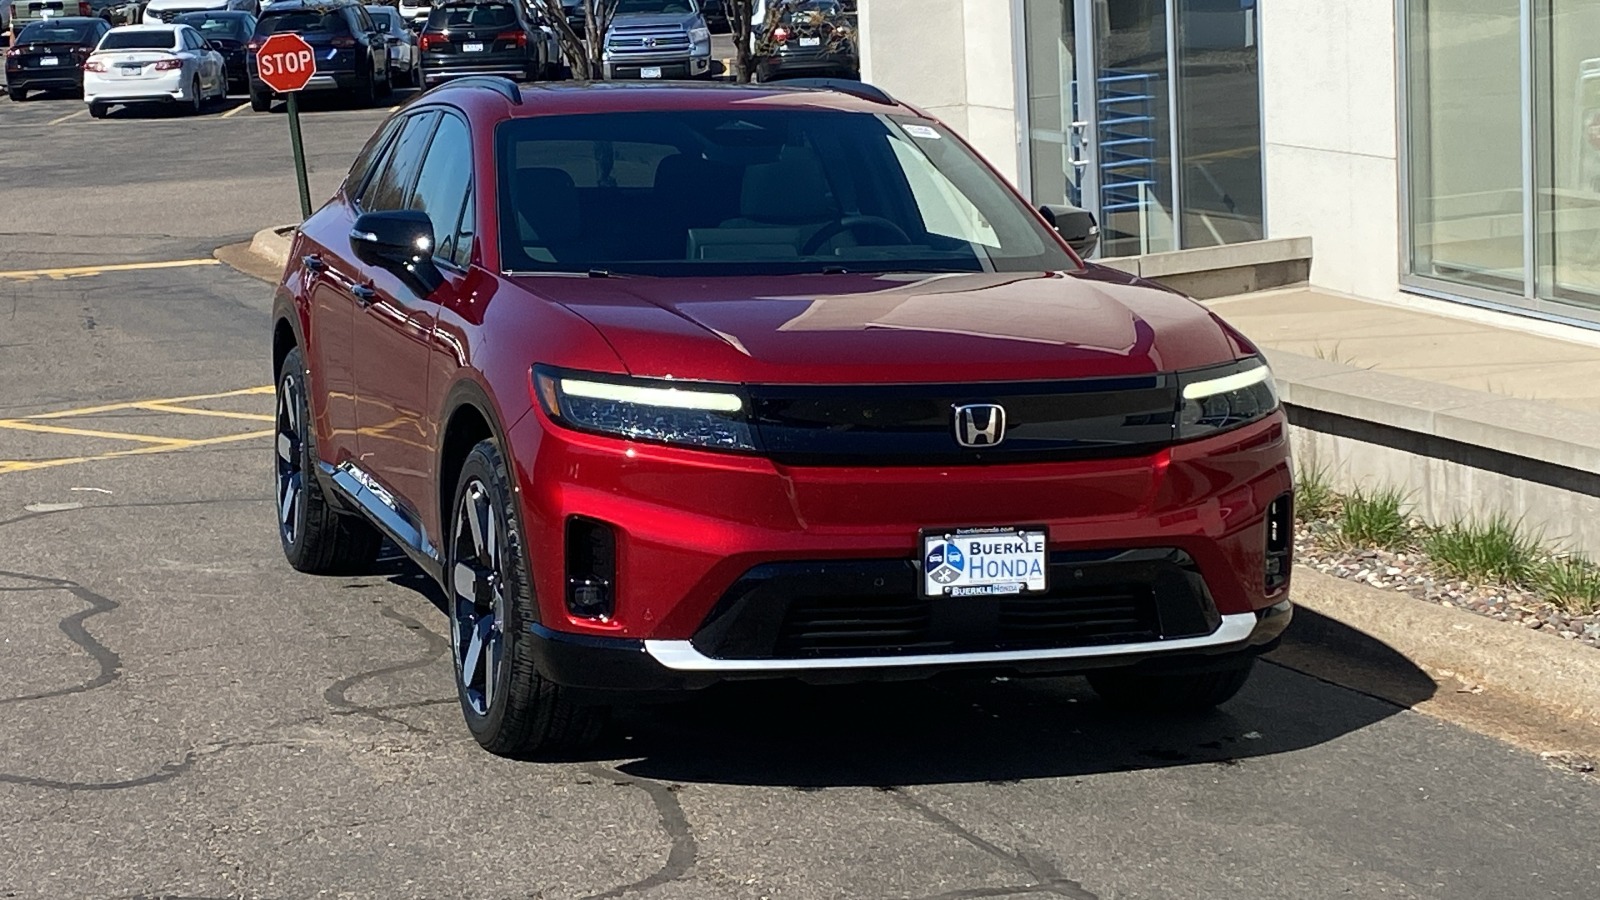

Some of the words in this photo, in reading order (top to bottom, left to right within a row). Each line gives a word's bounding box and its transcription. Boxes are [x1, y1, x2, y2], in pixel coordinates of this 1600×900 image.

[261, 50, 311, 75] STOP
[970, 541, 1044, 556] BUERKLE
[969, 556, 1043, 579] HONDA
[952, 586, 992, 596] BUERKLE
[993, 584, 1018, 593] HONDA
